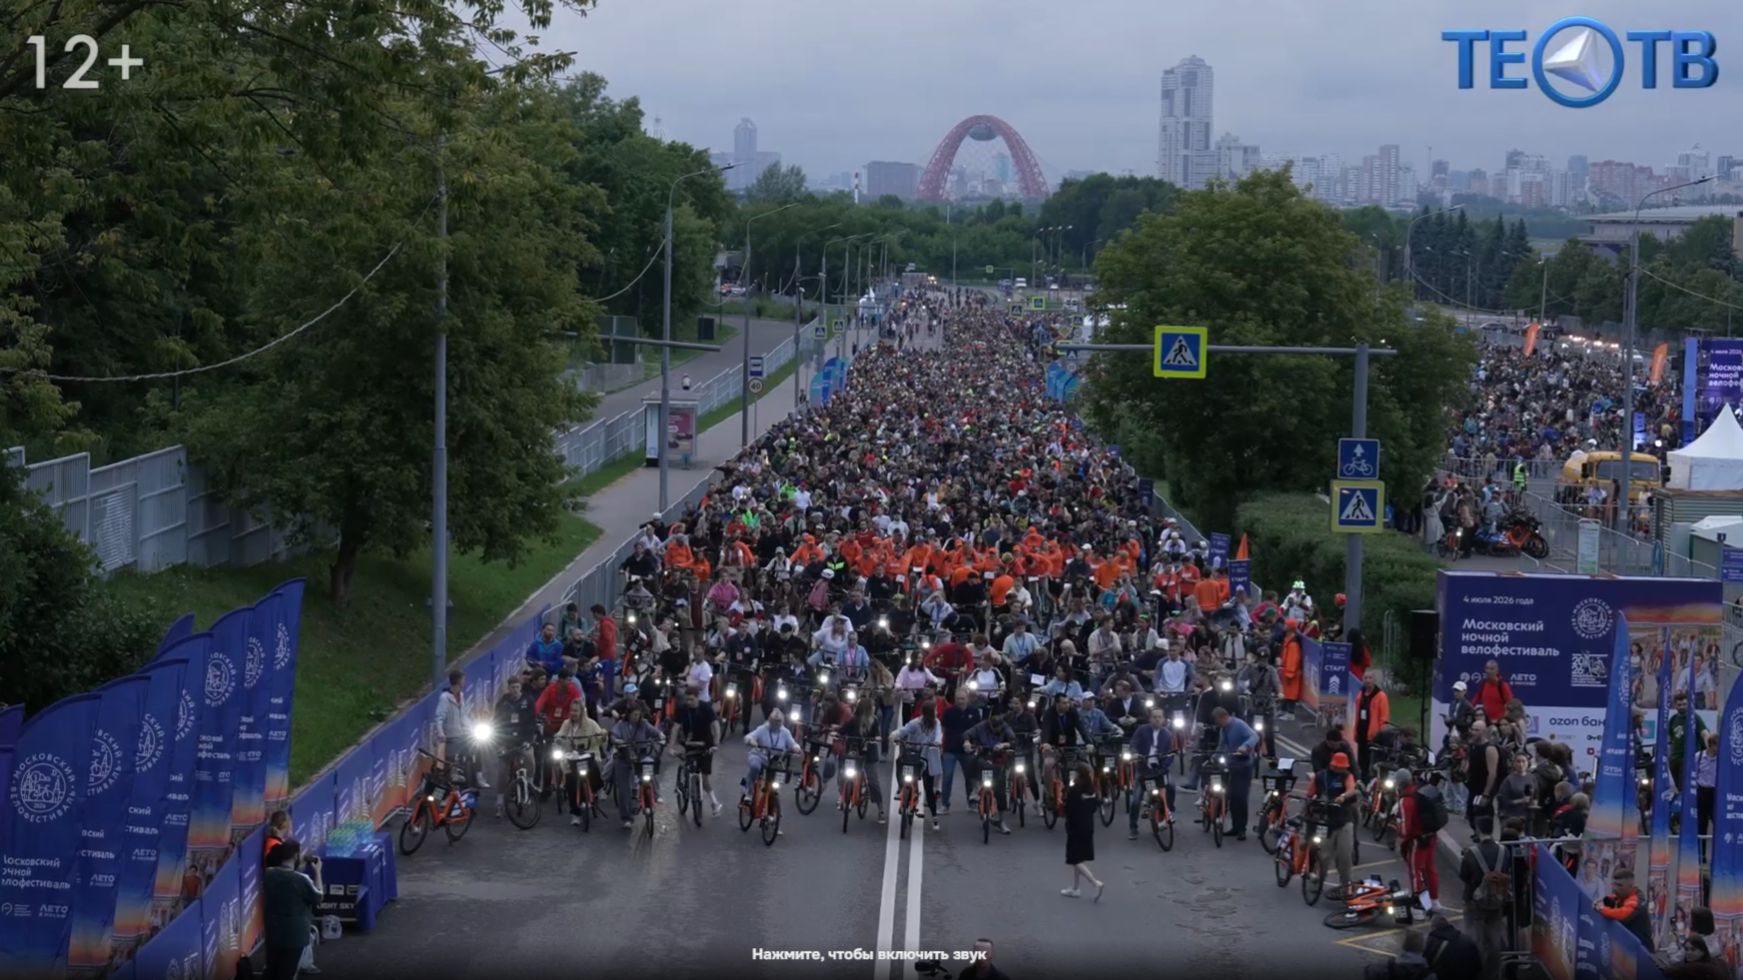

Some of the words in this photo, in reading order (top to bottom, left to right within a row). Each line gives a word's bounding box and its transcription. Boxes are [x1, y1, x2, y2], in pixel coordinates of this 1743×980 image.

[1463, 595, 1469, 603] 4
[1493, 596, 1515, 604] 2026
[1516, 597, 1534, 606] года
[1462, 619, 1544, 632] Московский
[1461, 633, 1509, 644] ночной
[1460, 644, 1560, 658] велофестиваль
[1324, 664, 1346, 672] СТАРТ
[1549, 716, 1579, 726] ozon
[13, 752, 76, 783] МОСКОВСКИЙ
[91, 874, 116, 882] ЛЕТО
[40, 904, 69, 914] ЛЕТО
